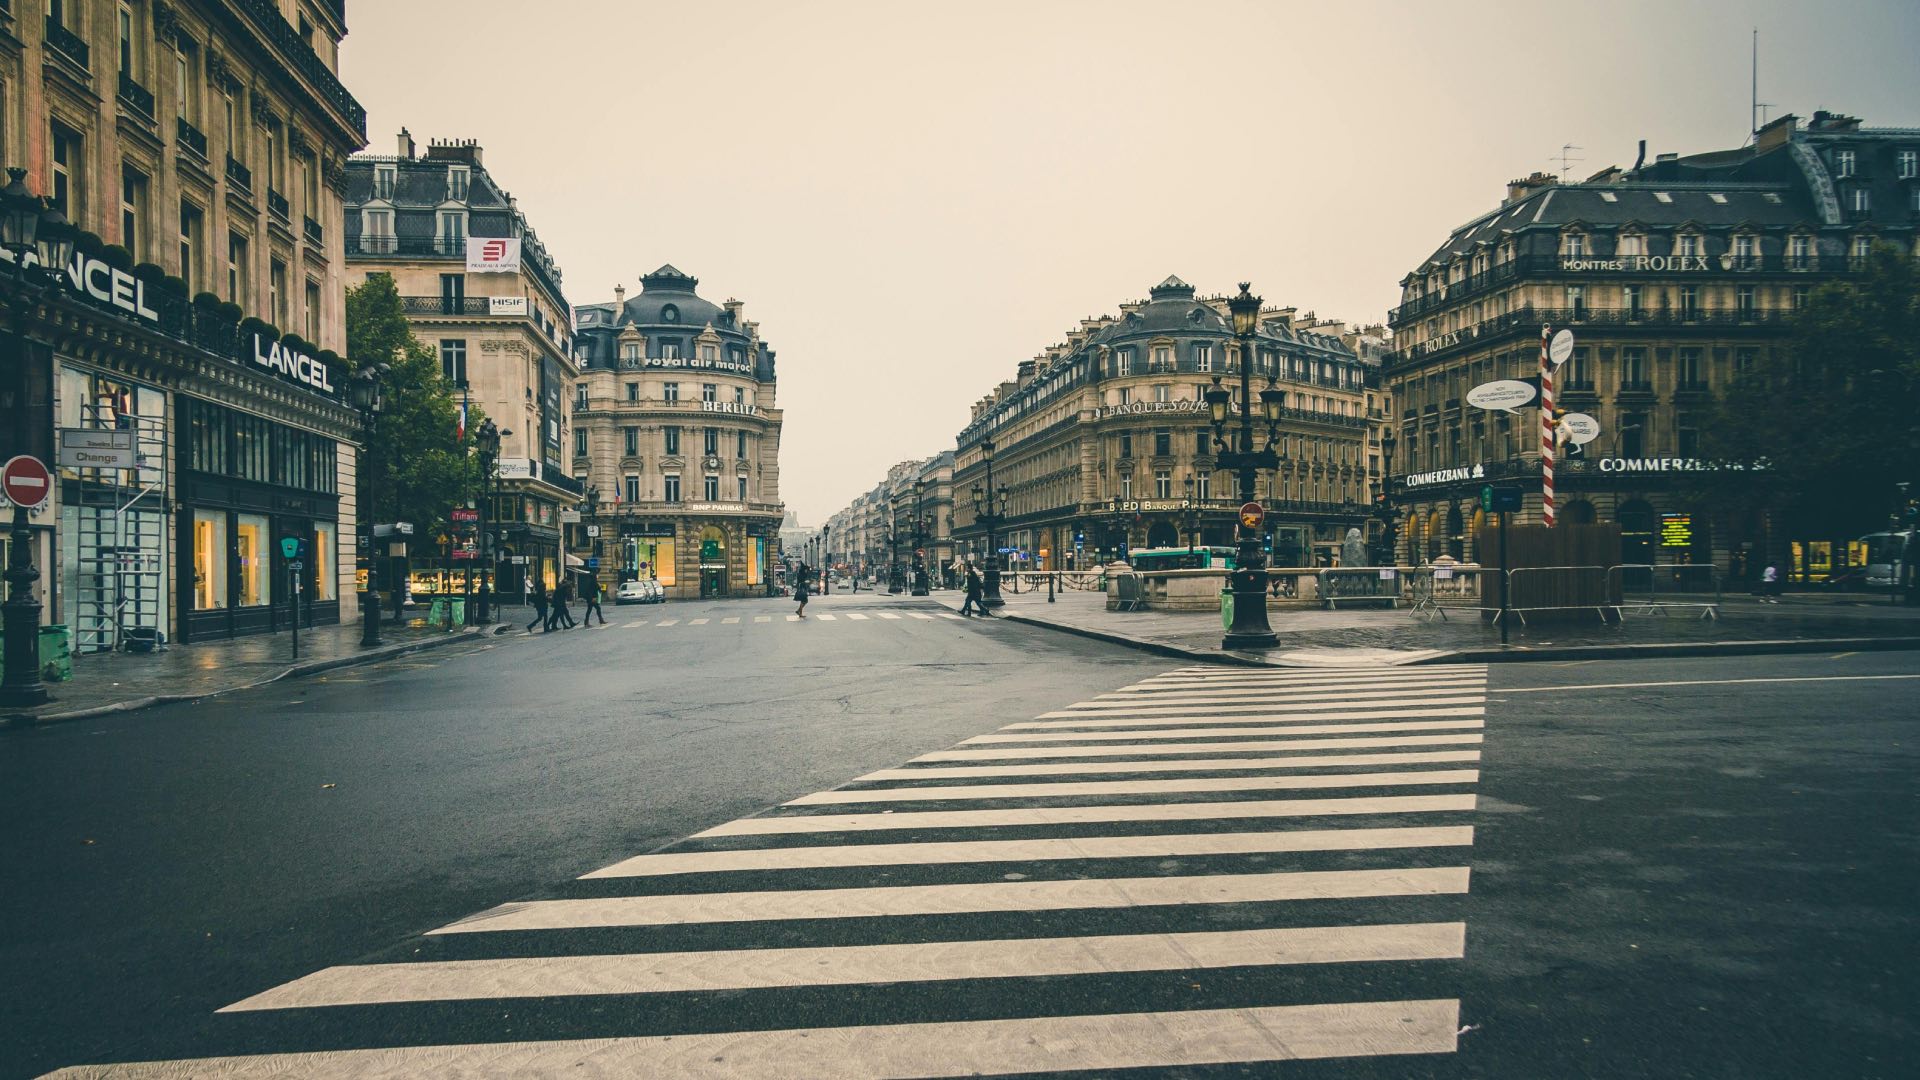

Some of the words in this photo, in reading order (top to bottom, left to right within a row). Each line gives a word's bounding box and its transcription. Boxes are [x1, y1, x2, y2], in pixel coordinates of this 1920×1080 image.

[1563, 260, 1624, 270] MONTRES
[1635, 255, 1710, 271] ROLEX
[0, 247, 158, 322] NCEL
[492, 298, 524, 306] HISIF
[1425, 330, 1460, 354] ROLEX
[254, 333, 334, 393] LANCEL
[644, 357, 687, 367] royal
[690, 359, 712, 368] air
[715, 360, 751, 373] maroc
[703, 401, 758, 416] BERLITZ
[1109, 401, 1164, 415] BANQUE
[1168, 399, 1209, 413] Solfe
[76, 452, 118, 464] Change
[1406, 467, 1469, 487] COMMERZBANK
[711, 504, 744, 512] PARIBAS
